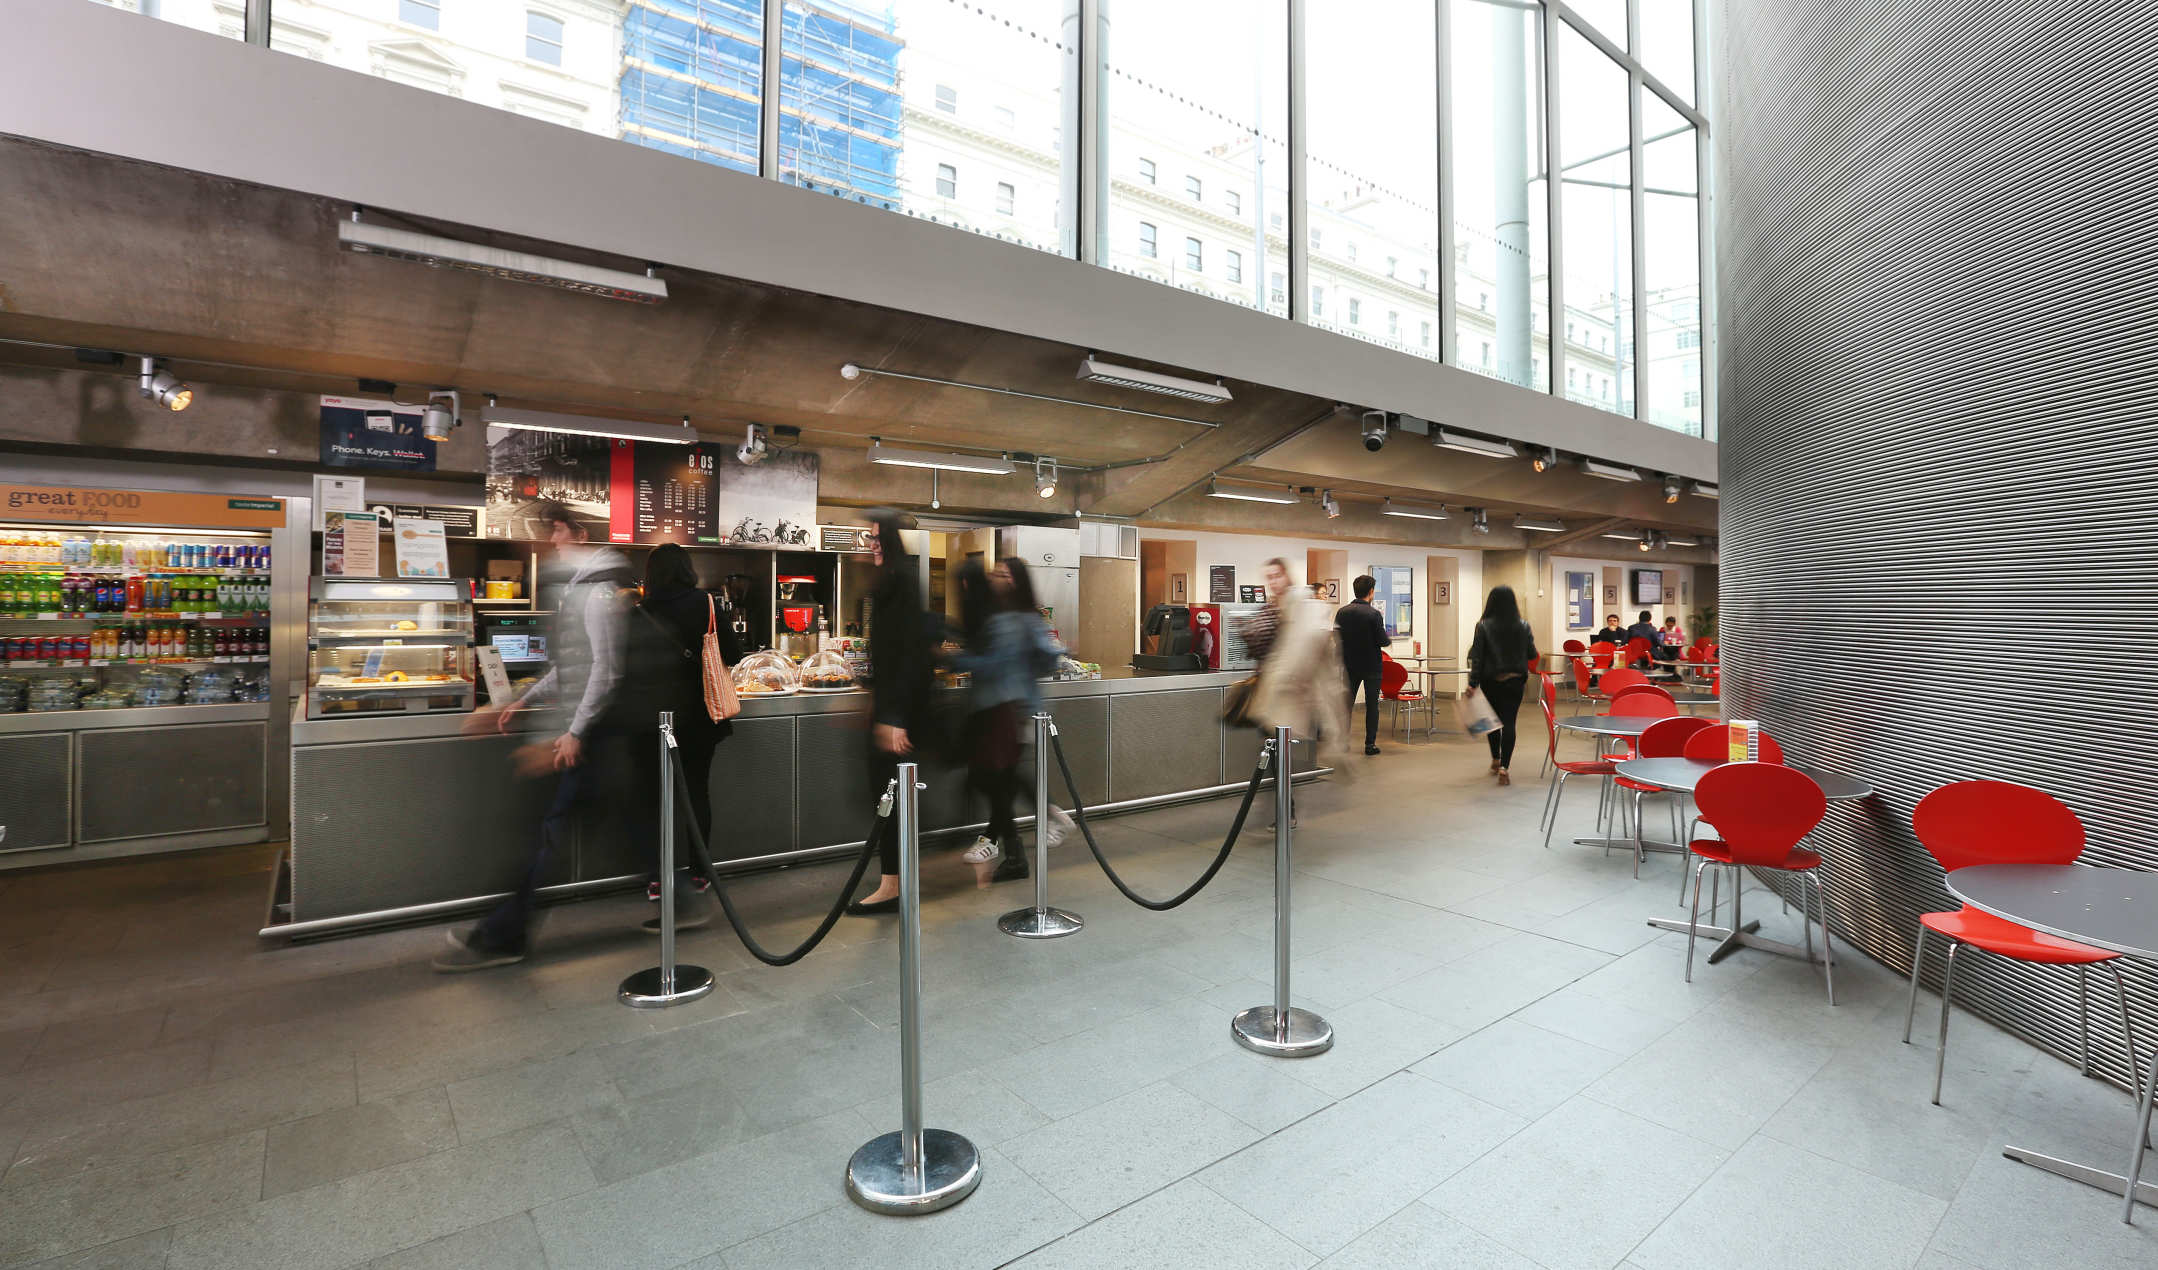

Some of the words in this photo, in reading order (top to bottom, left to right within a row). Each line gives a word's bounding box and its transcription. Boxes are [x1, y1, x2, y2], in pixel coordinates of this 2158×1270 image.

[331, 444, 366, 454] Phone.
[366, 448, 392, 457] Keys.
[688, 468, 713, 476] coffee
[8, 490, 77, 508] great
[81, 492, 141, 509] FOOD
[48, 507, 108, 521] everyday
[1177, 580, 1184, 593] 1
[1329, 583, 1337, 598] 2
[1440, 586, 1447, 597] 3
[1607, 590, 1614, 599] 5
